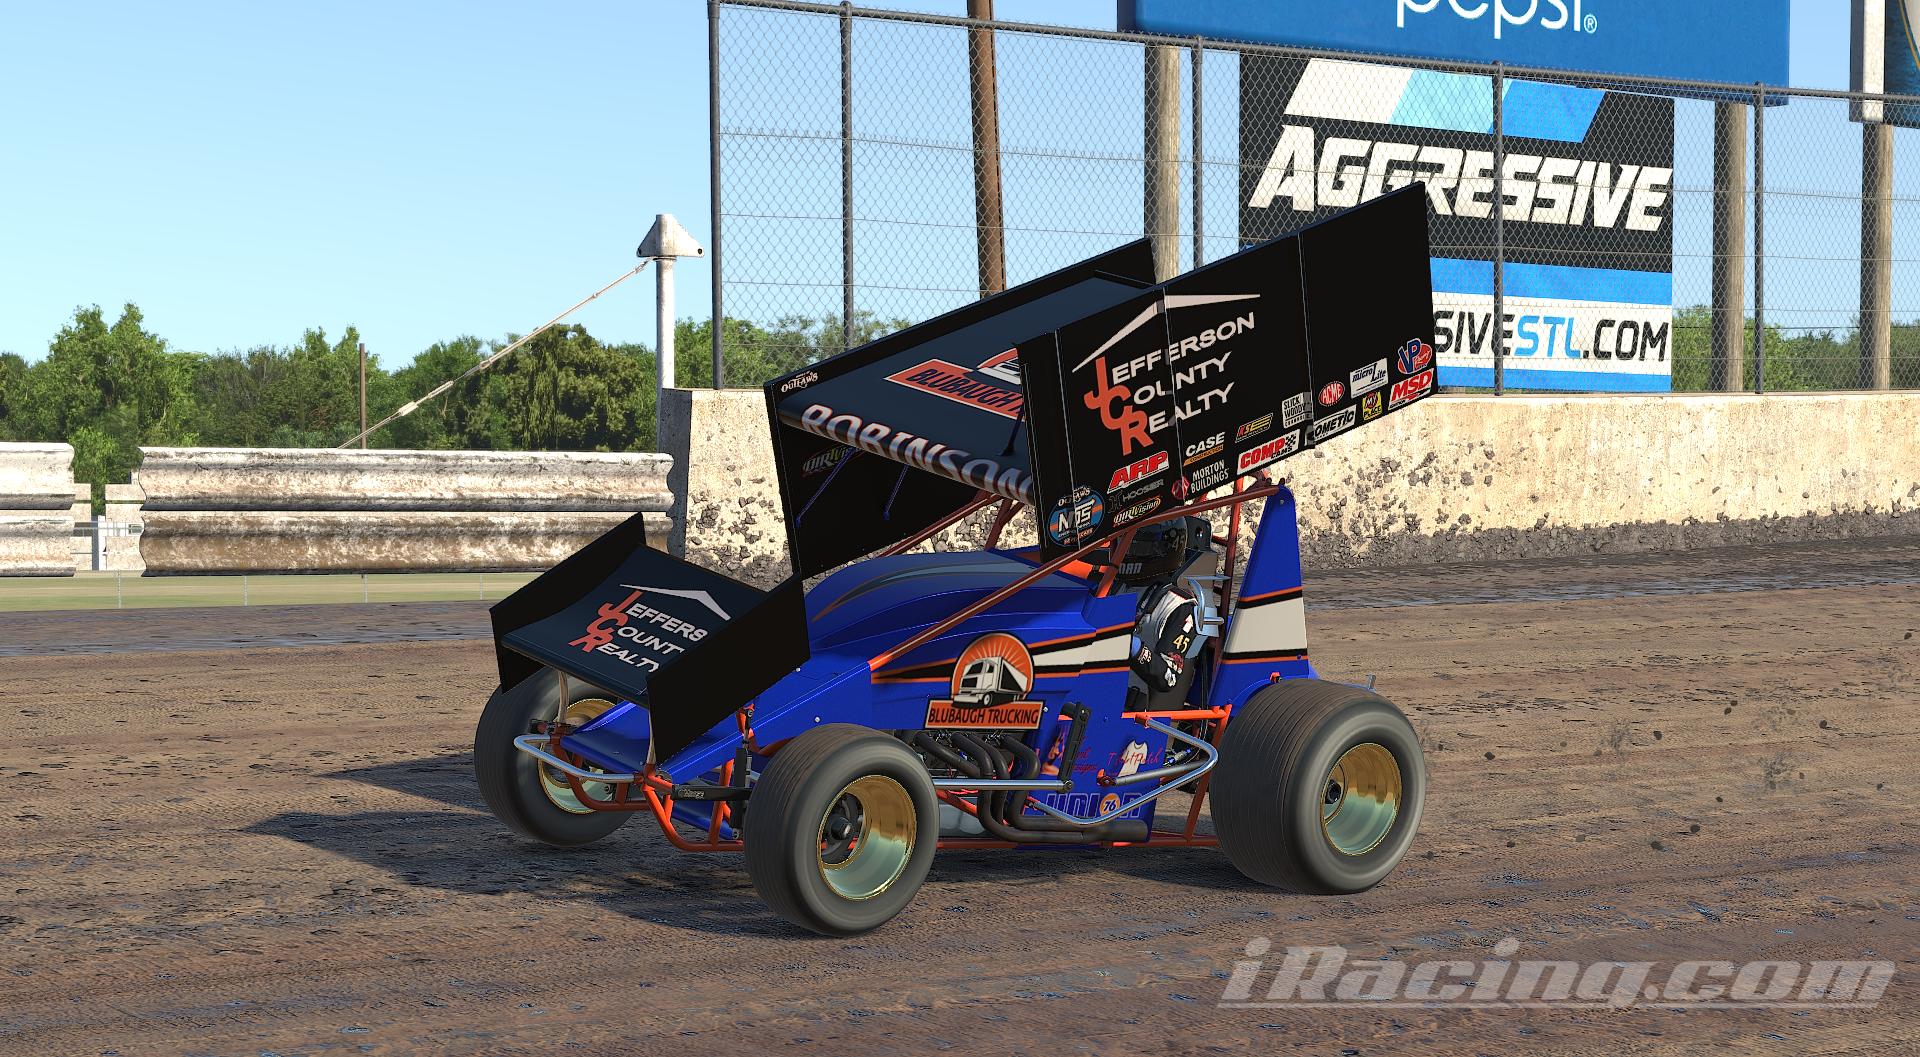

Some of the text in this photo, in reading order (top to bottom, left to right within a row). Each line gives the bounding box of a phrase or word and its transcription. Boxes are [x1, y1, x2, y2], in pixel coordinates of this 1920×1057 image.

[1248, 124, 1673, 231] AGGRESSIVE
[1084, 312, 1255, 409] JEFFERSON
[1398, 338, 1421, 374] VP
[905, 368, 1023, 412] BLUBAUGH
[1321, 383, 1342, 405] ACME
[1391, 370, 1432, 401] MSD
[1185, 431, 1226, 457] CASE
[1240, 437, 1286, 470] COMP
[1109, 451, 1168, 490] ARP
[1190, 469, 1230, 494] BUILDINGS
[1192, 460, 1225, 482] MORTON
[587, 612, 685, 655] COUNT
[1173, 634, 1191, 653] 45
[928, 708, 1039, 724] BLUBAUGH TRUCKING
[1103, 800, 1117, 812] 76
